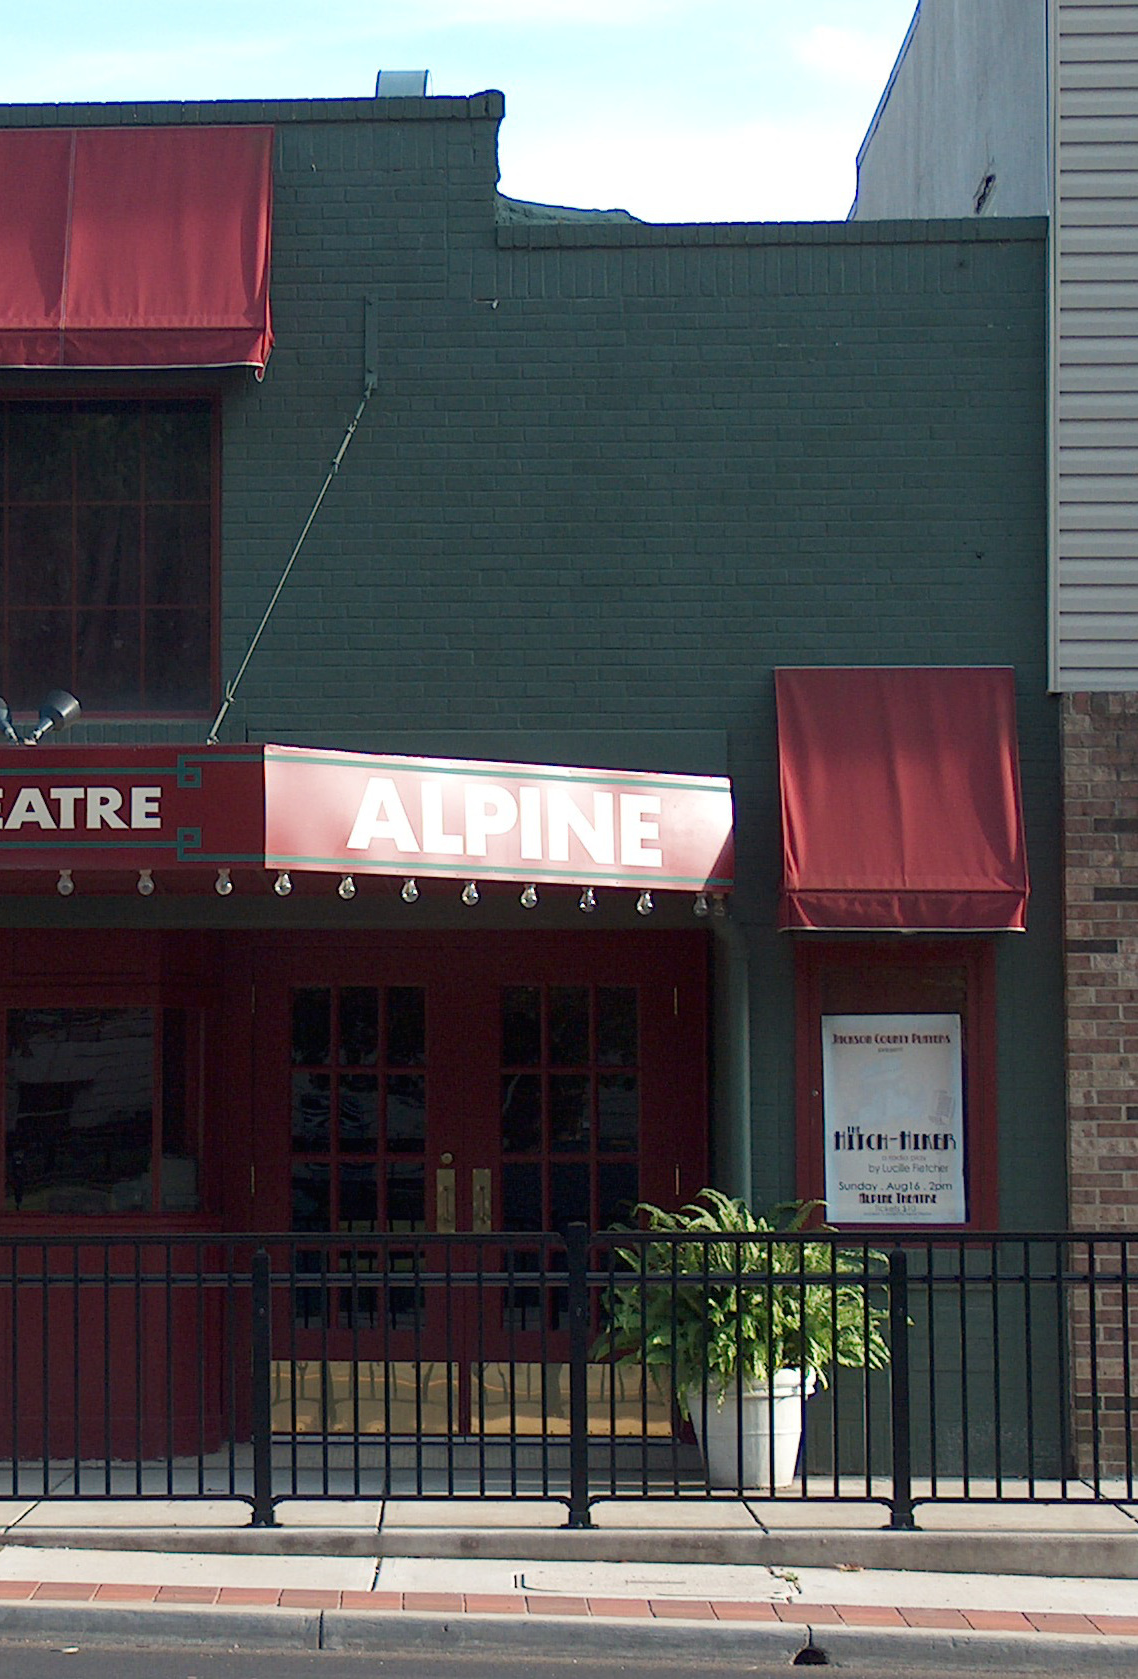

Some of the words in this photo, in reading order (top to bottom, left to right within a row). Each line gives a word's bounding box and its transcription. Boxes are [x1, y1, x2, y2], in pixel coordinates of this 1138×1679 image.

[346, 777, 663, 868] ALPINE
[832, 1034, 872, 1044] JACKSON
[875, 1034, 909, 1044] COUNTY
[911, 1033, 951, 1044] PLAYERS
[834, 1131, 957, 1151] HITCH-HIKER
[868, 1164, 880, 1175] by
[882, 1163, 910, 1174] Lucille
[912, 1163, 949, 1174] Fletcher
[839, 1182, 878, 1193] Sunday
[859, 1193, 892, 1204] ALPINE
[896, 1193, 937, 1204] THEATRE
